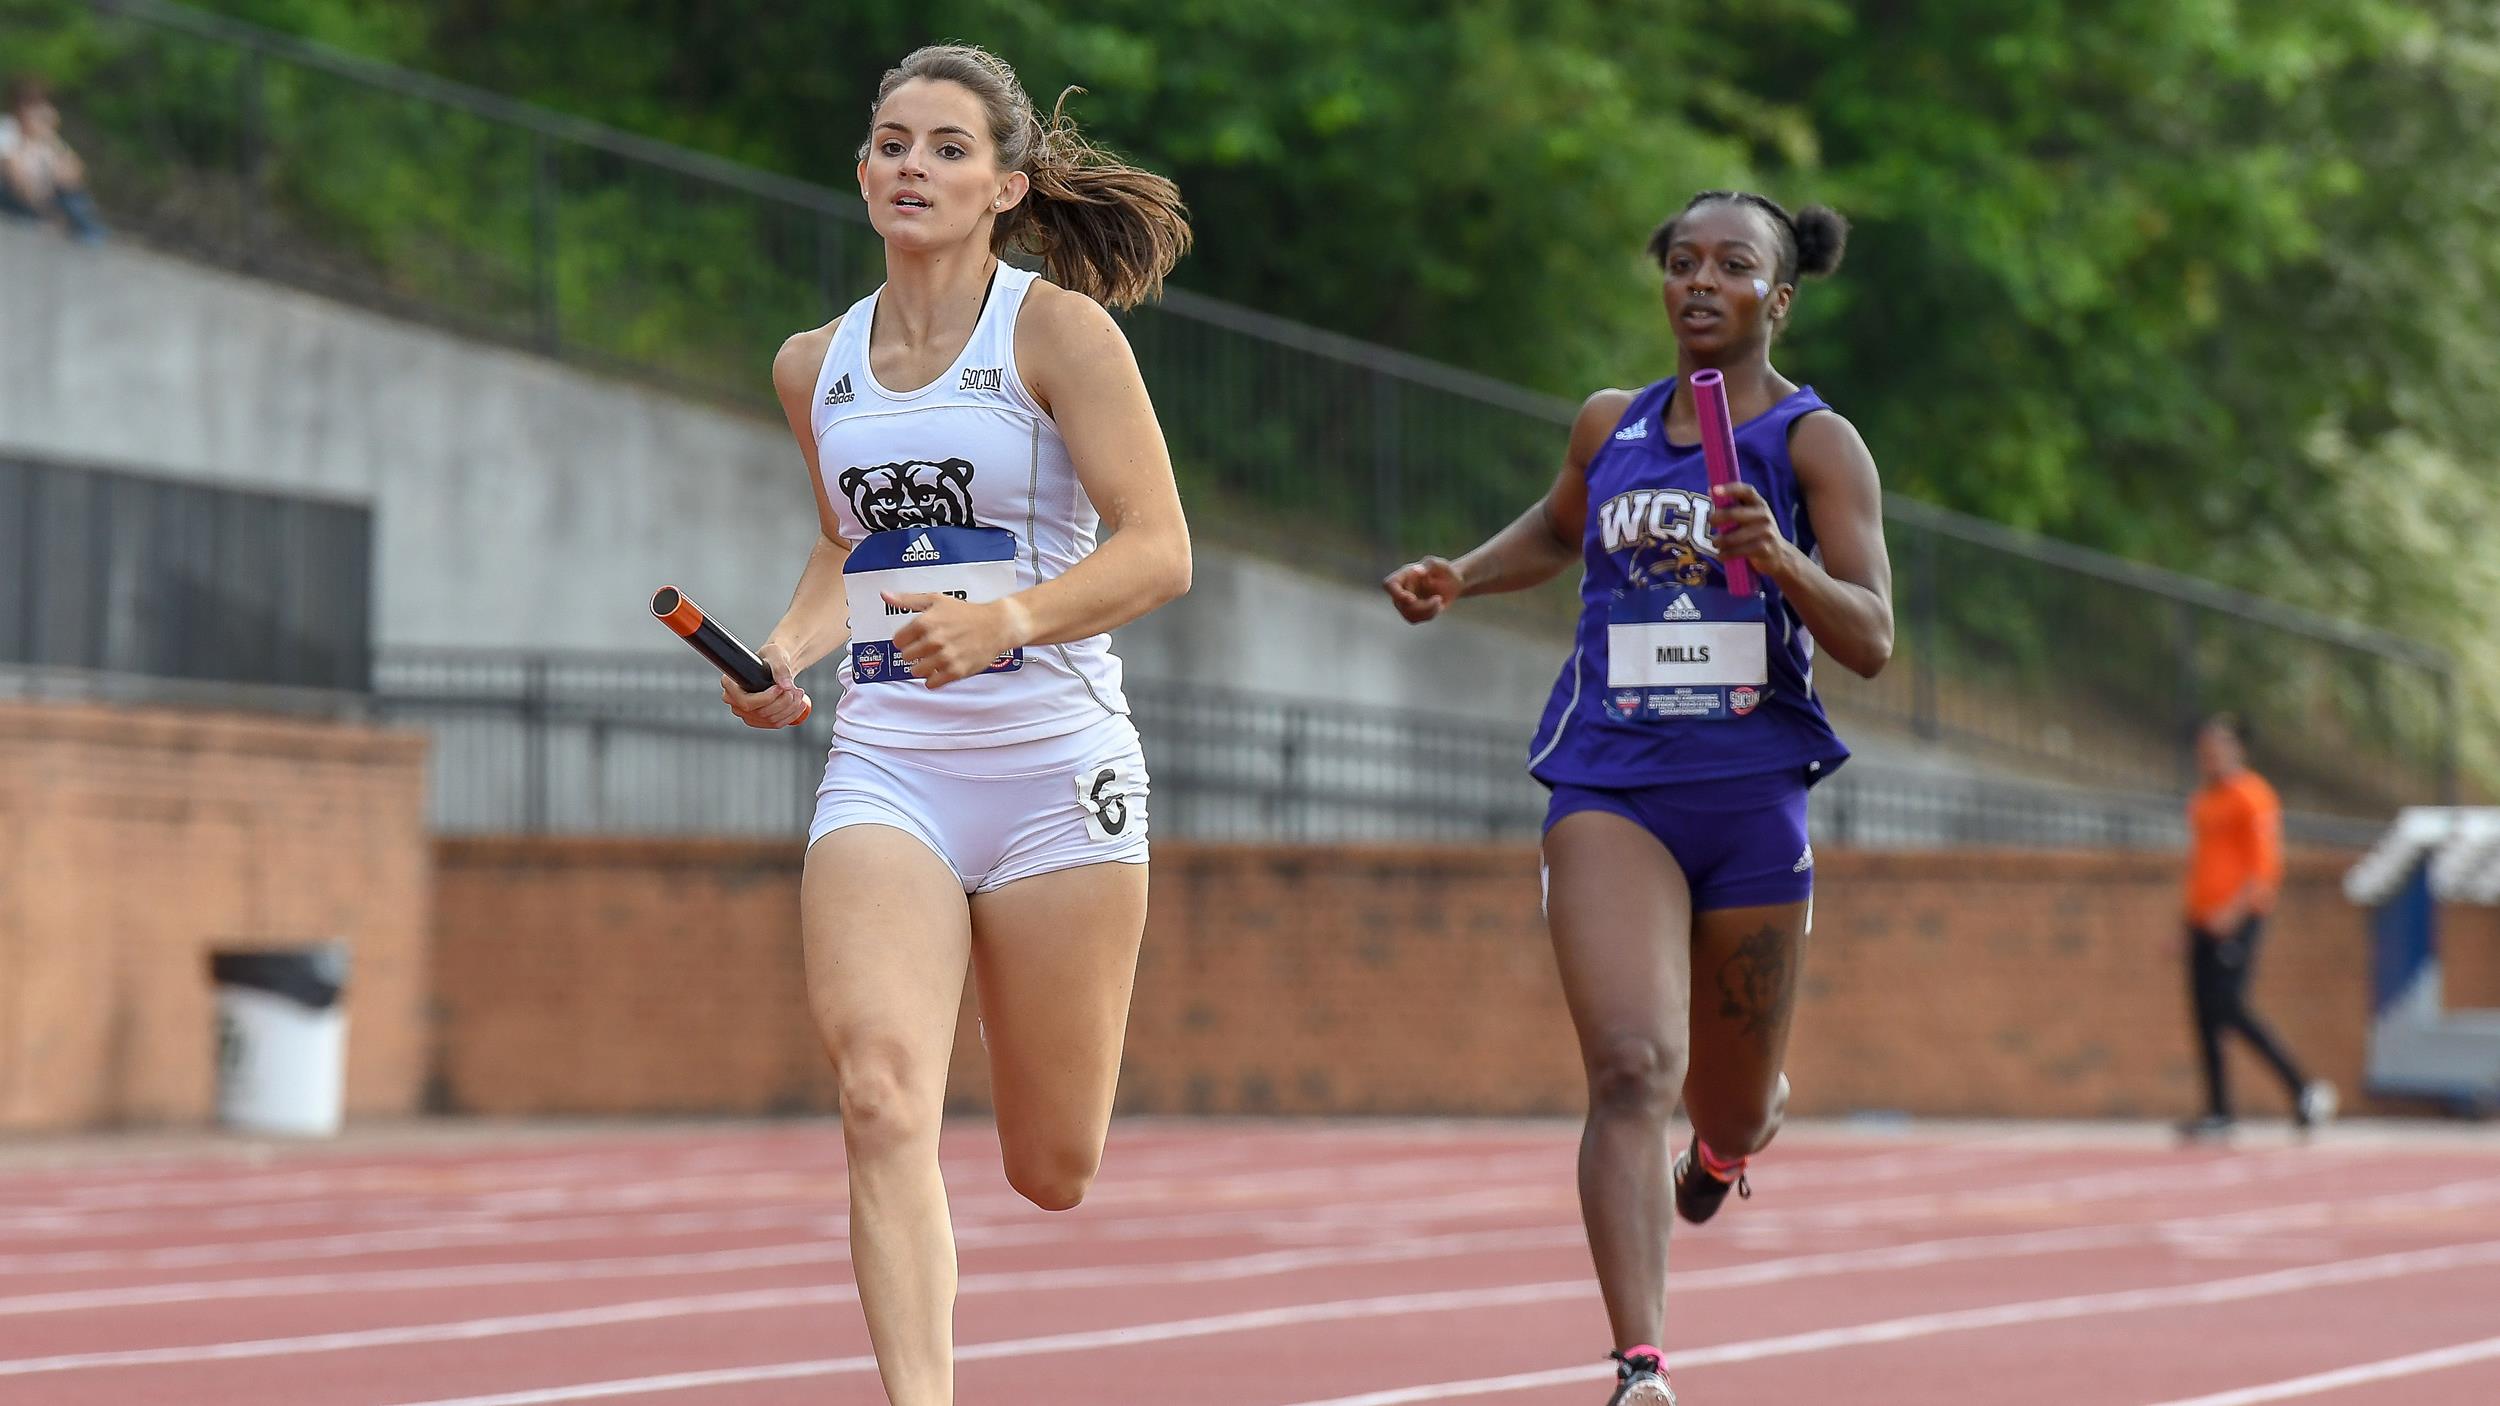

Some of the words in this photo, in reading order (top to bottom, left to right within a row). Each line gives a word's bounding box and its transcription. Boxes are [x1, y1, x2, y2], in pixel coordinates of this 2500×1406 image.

[959, 367, 1003, 392] SOCON
[824, 391, 855, 405] adidas
[901, 549, 940, 561] adidas
[1656, 646, 1710, 663] MILLS
